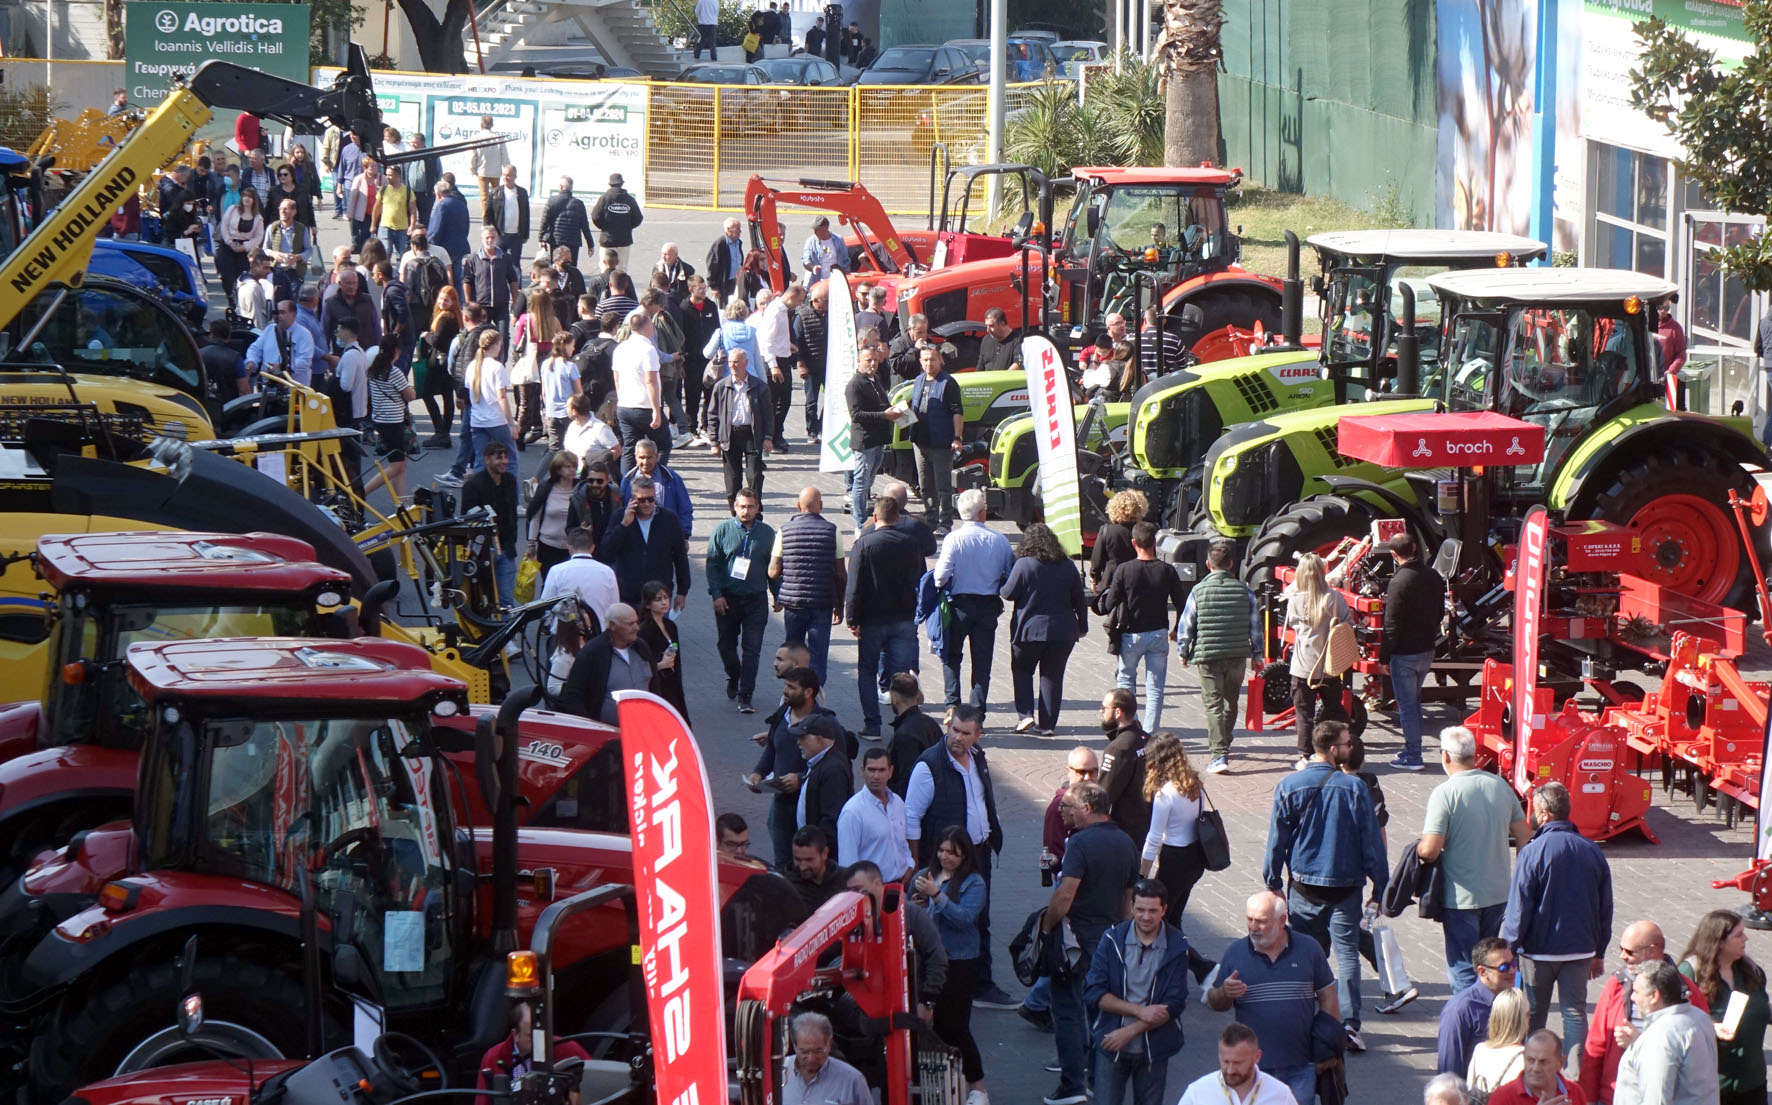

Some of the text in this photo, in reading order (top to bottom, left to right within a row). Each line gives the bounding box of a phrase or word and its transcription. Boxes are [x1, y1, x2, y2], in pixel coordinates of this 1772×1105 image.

[183, 13, 283, 36] Agrotica
[155, 40, 283, 54] Ioannis Vellidis Hall
[569, 130, 639, 149] Agrotica
[10, 167, 136, 294] NEW HOLLAND
[1280, 368, 1318, 377] CLAAS
[1, 396, 27, 405] NEW
[1446, 440, 1493, 454] broch
[529, 740, 563, 758] 140
[794, 944, 808, 968] RADIO
